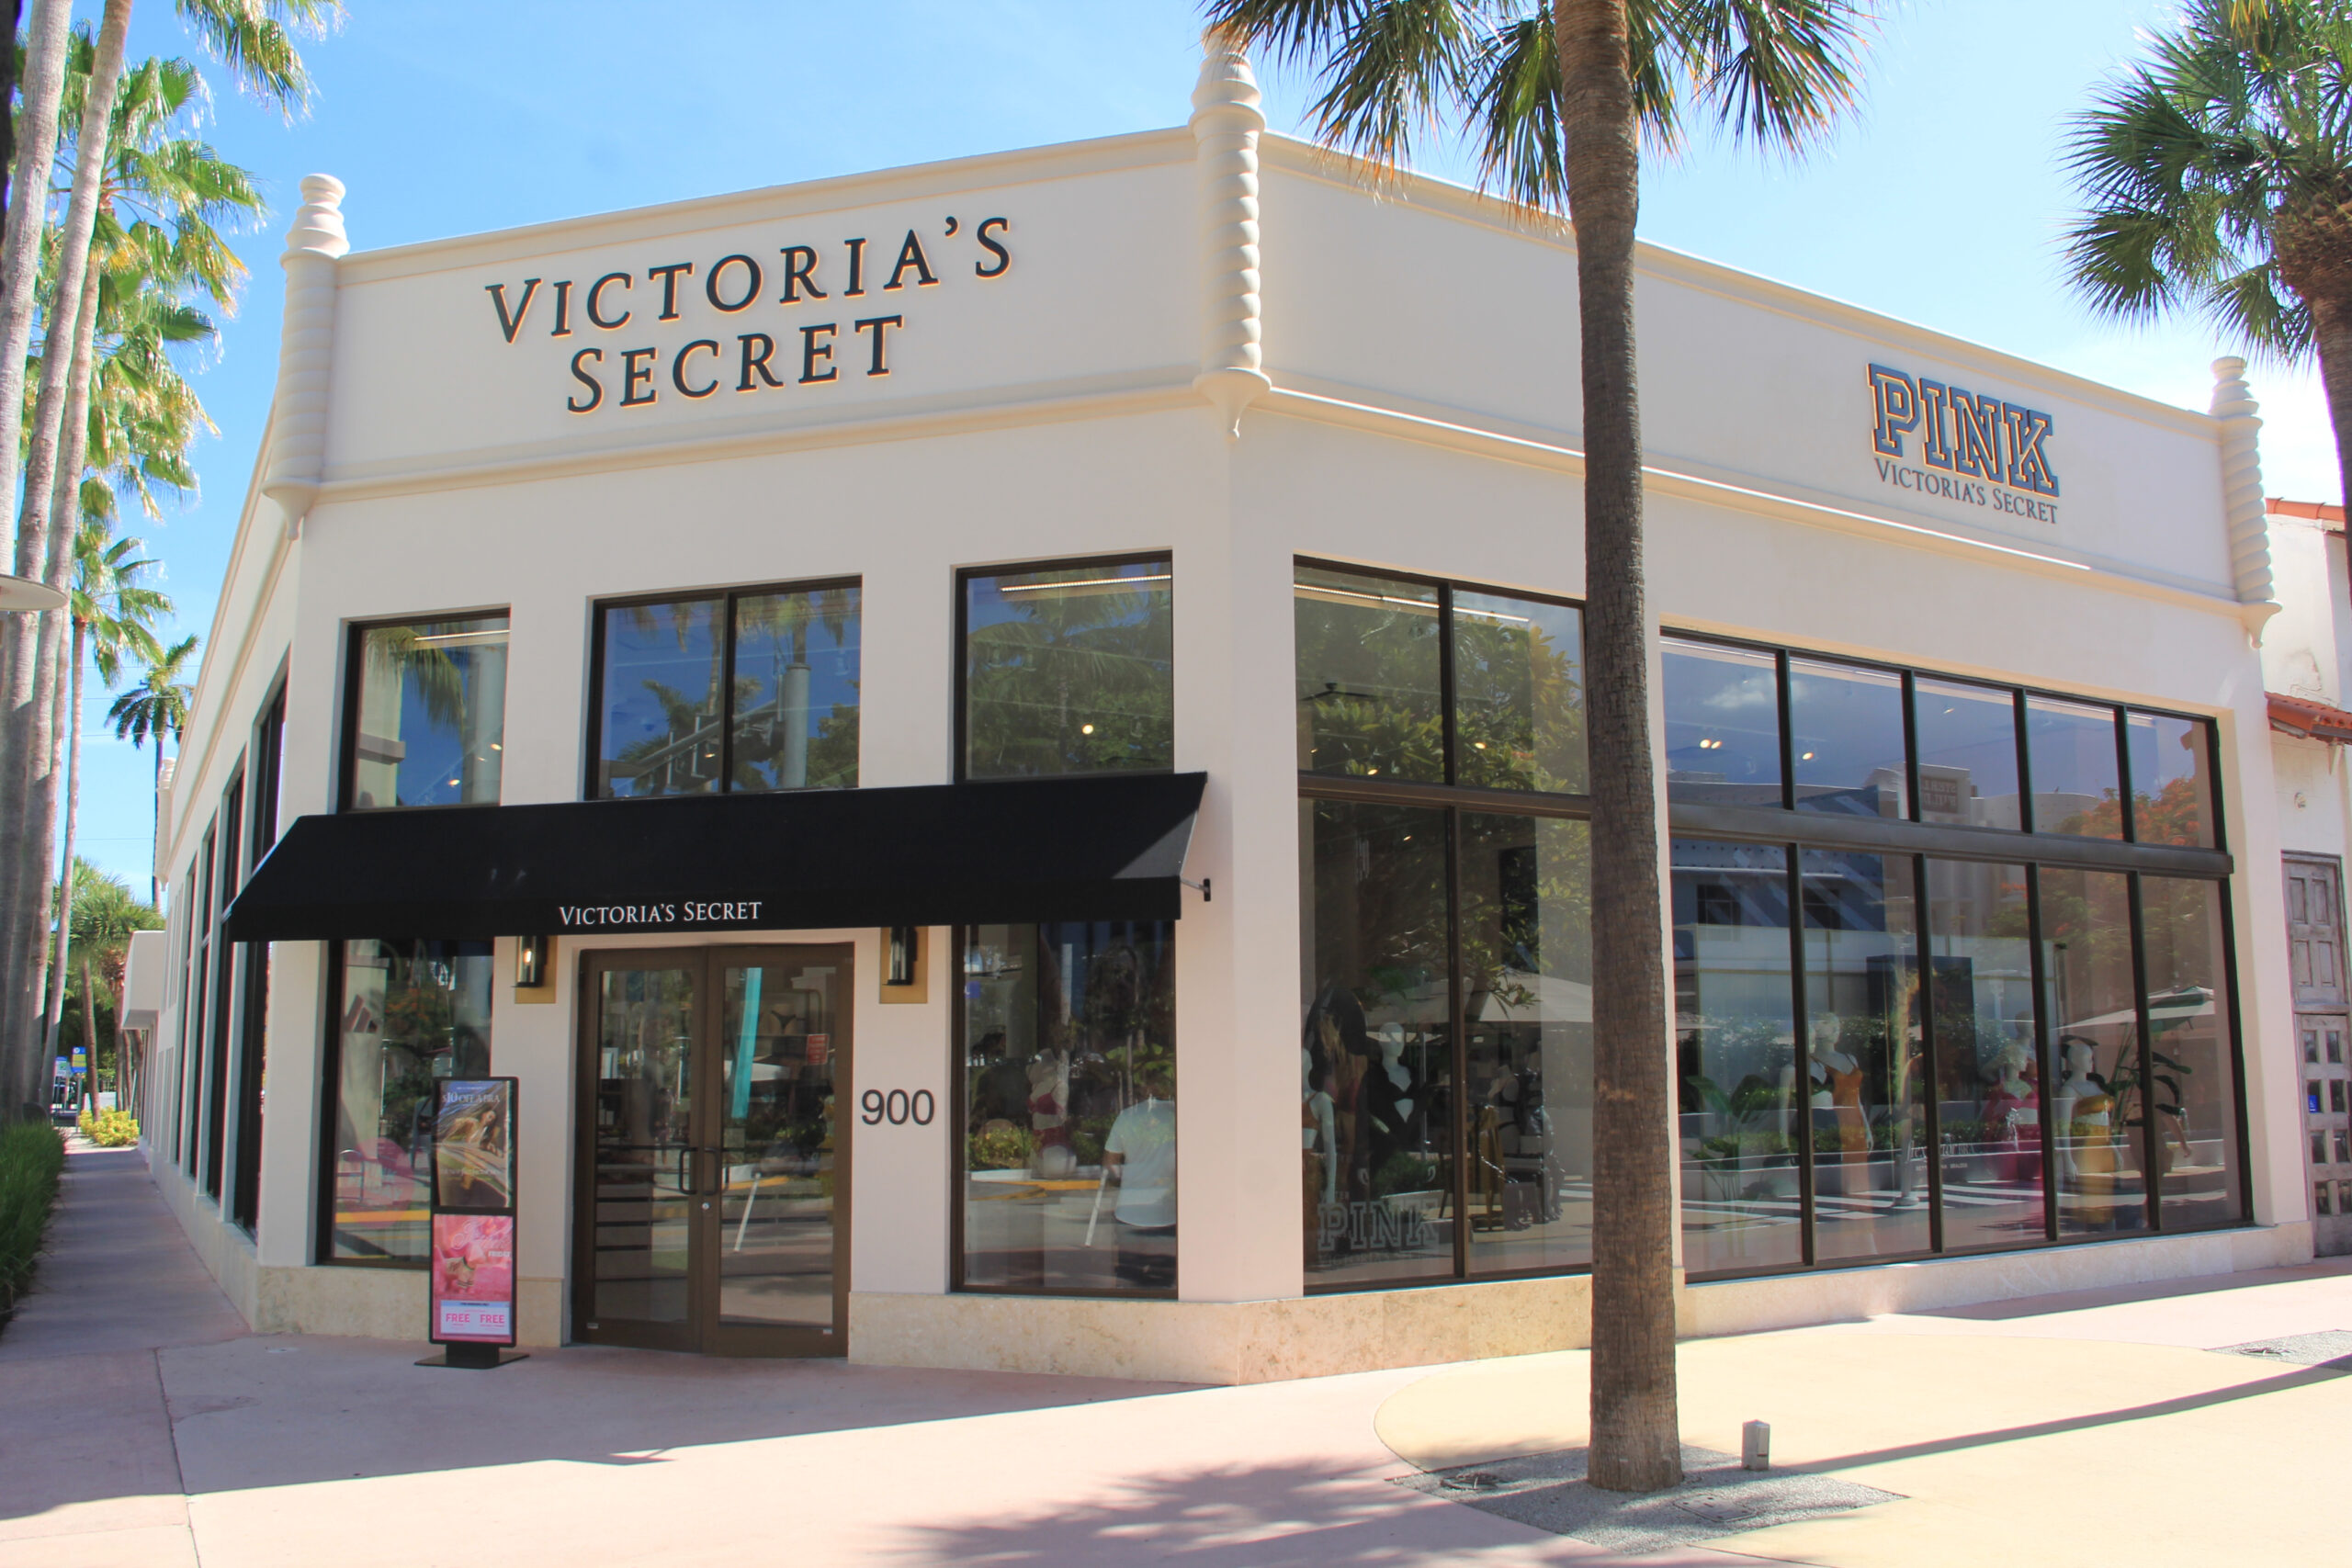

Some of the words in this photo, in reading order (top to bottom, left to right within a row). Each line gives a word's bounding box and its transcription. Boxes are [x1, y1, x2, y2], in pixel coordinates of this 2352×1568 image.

[485, 216, 1012, 344] VICTORIA'S
[567, 314, 903, 413] SECRET
[1867, 363, 2060, 498] PINK
[1874, 457, 1986, 506] VICTORIA'S
[1992, 488, 2058, 525] SECRET
[559, 903, 675, 926] VICTORIA'S
[684, 901, 763, 921] SECRET
[861, 1089, 935, 1126] 900
[1317, 1198, 1439, 1253] PINK
[446, 1314, 470, 1323] FREE
[480, 1314, 505, 1324] FREE
